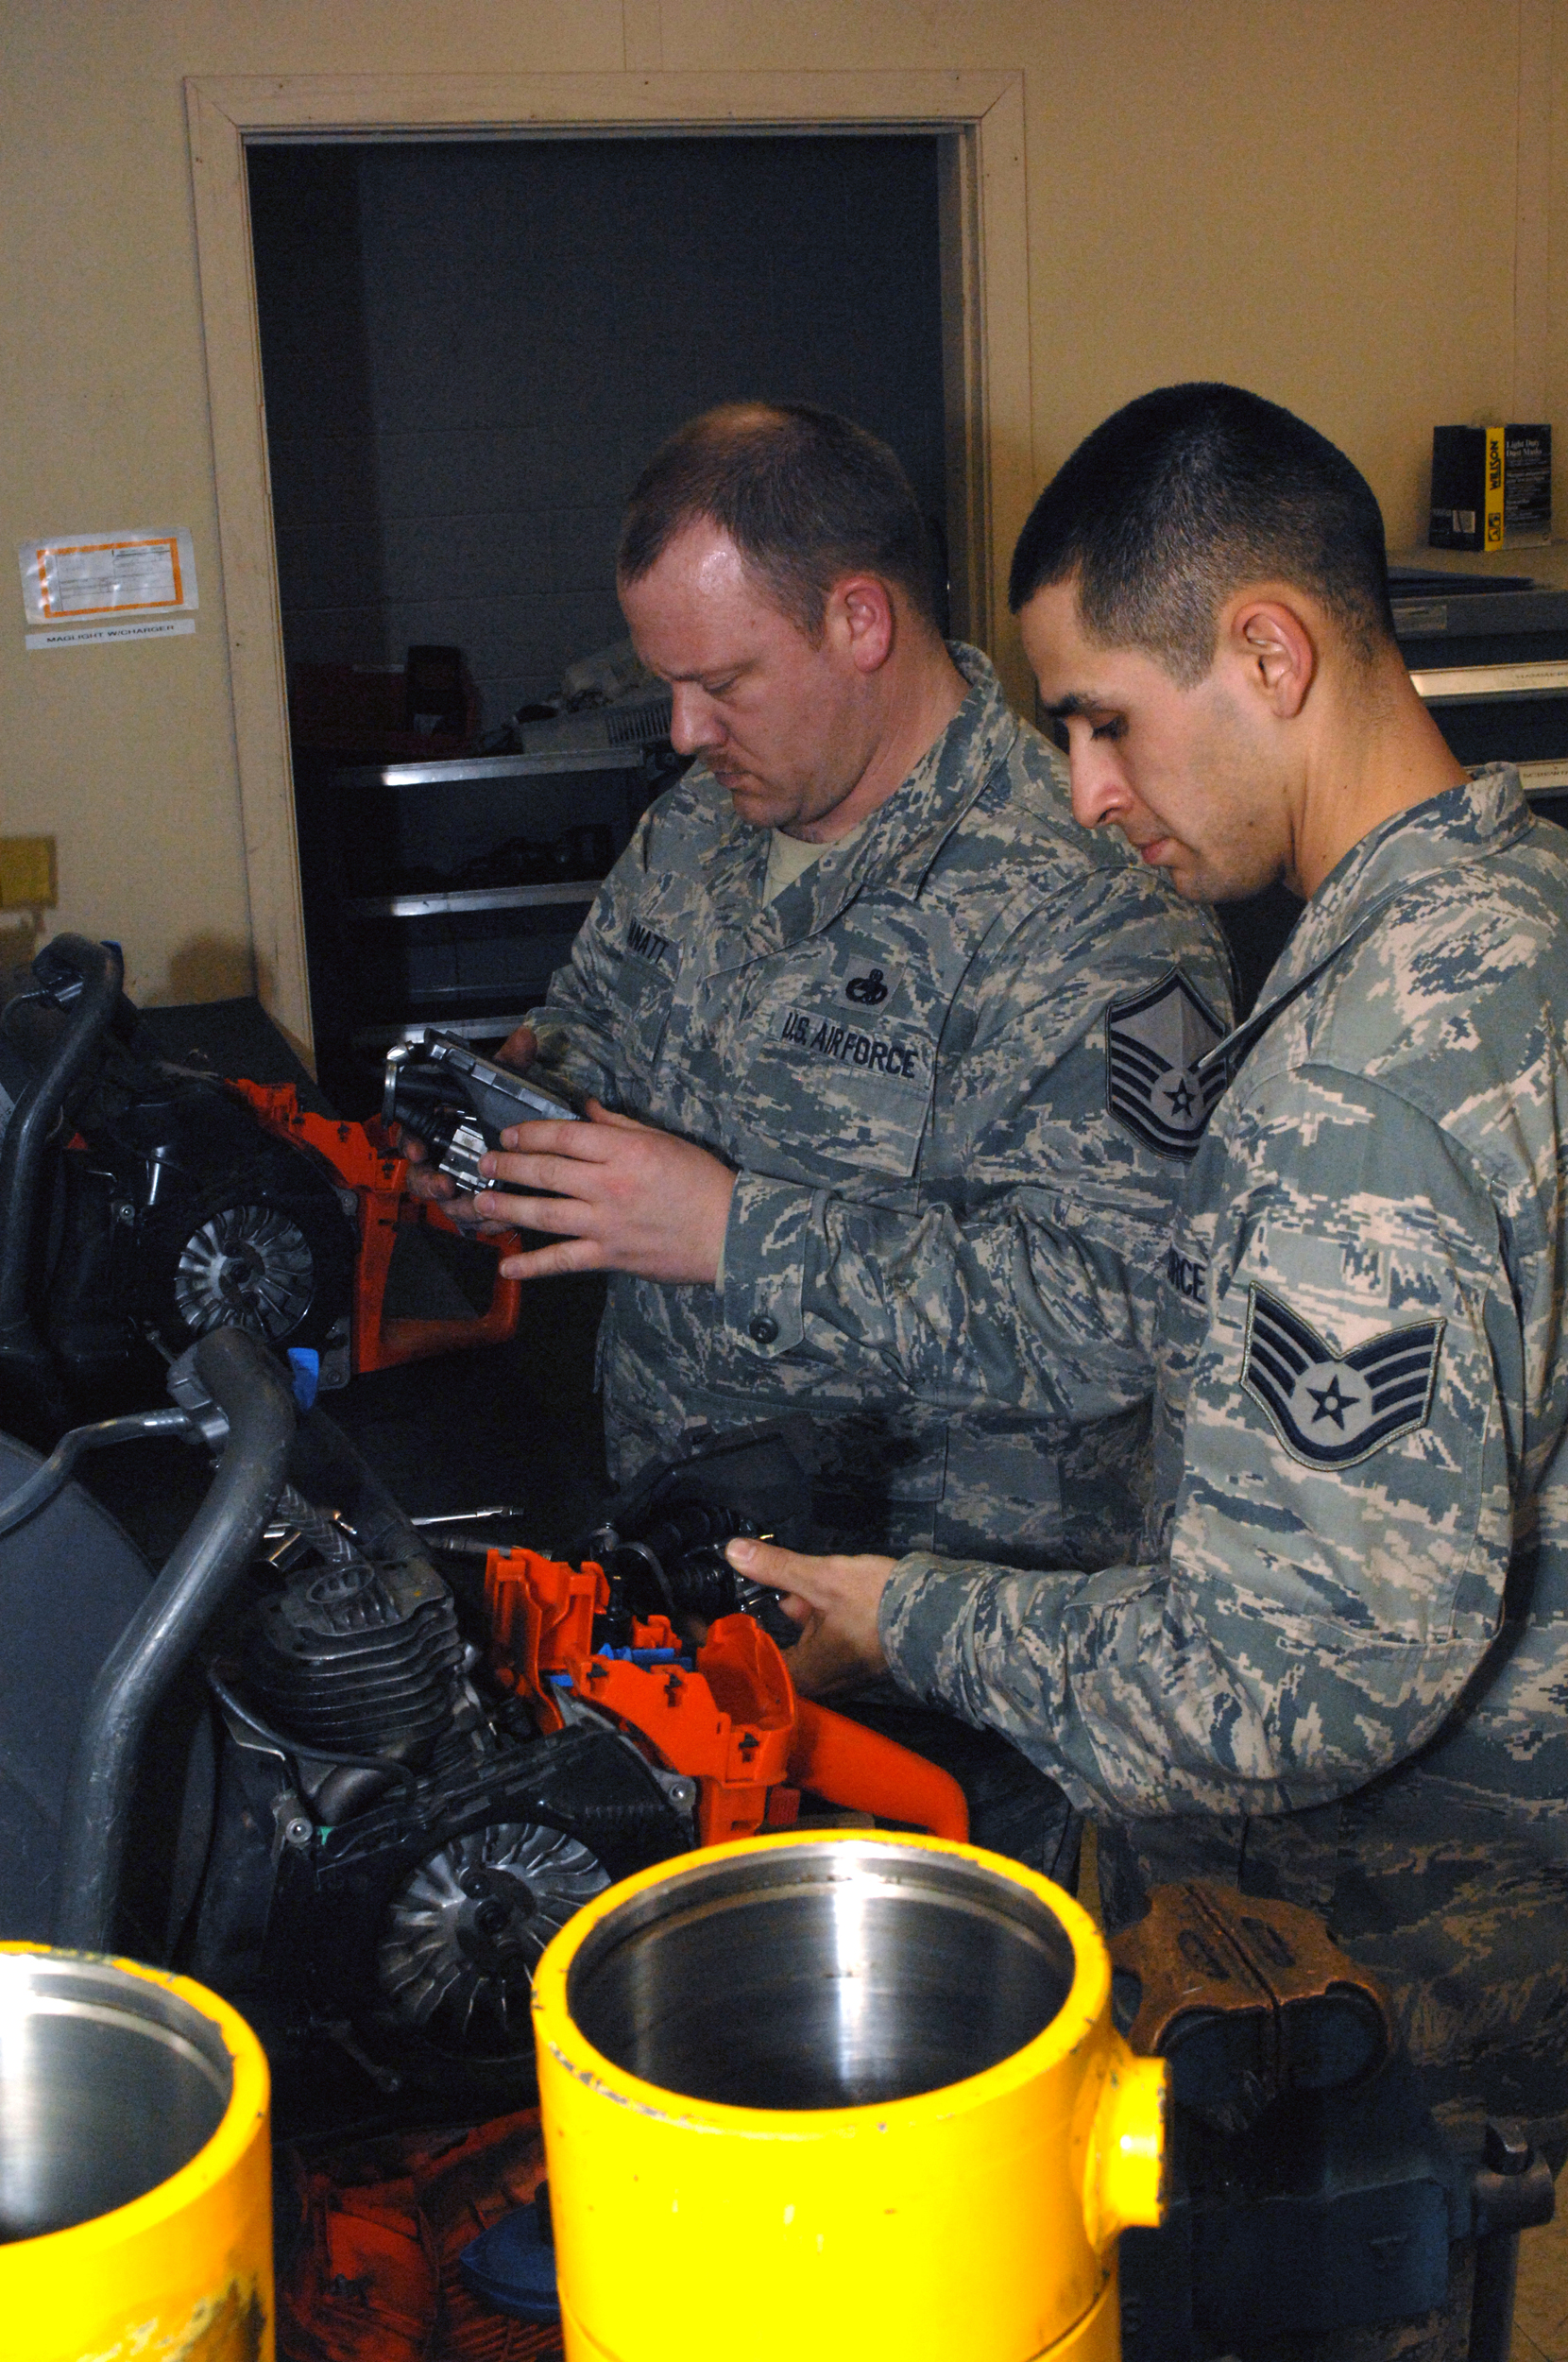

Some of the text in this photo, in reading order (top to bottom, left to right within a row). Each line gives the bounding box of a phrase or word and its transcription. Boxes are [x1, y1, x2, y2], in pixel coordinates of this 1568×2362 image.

[47, 625, 174, 642] MAGLIGHT W/CHARGER
[810, 1022, 844, 1055] AIR
[841, 1033, 918, 1078] FORCE
